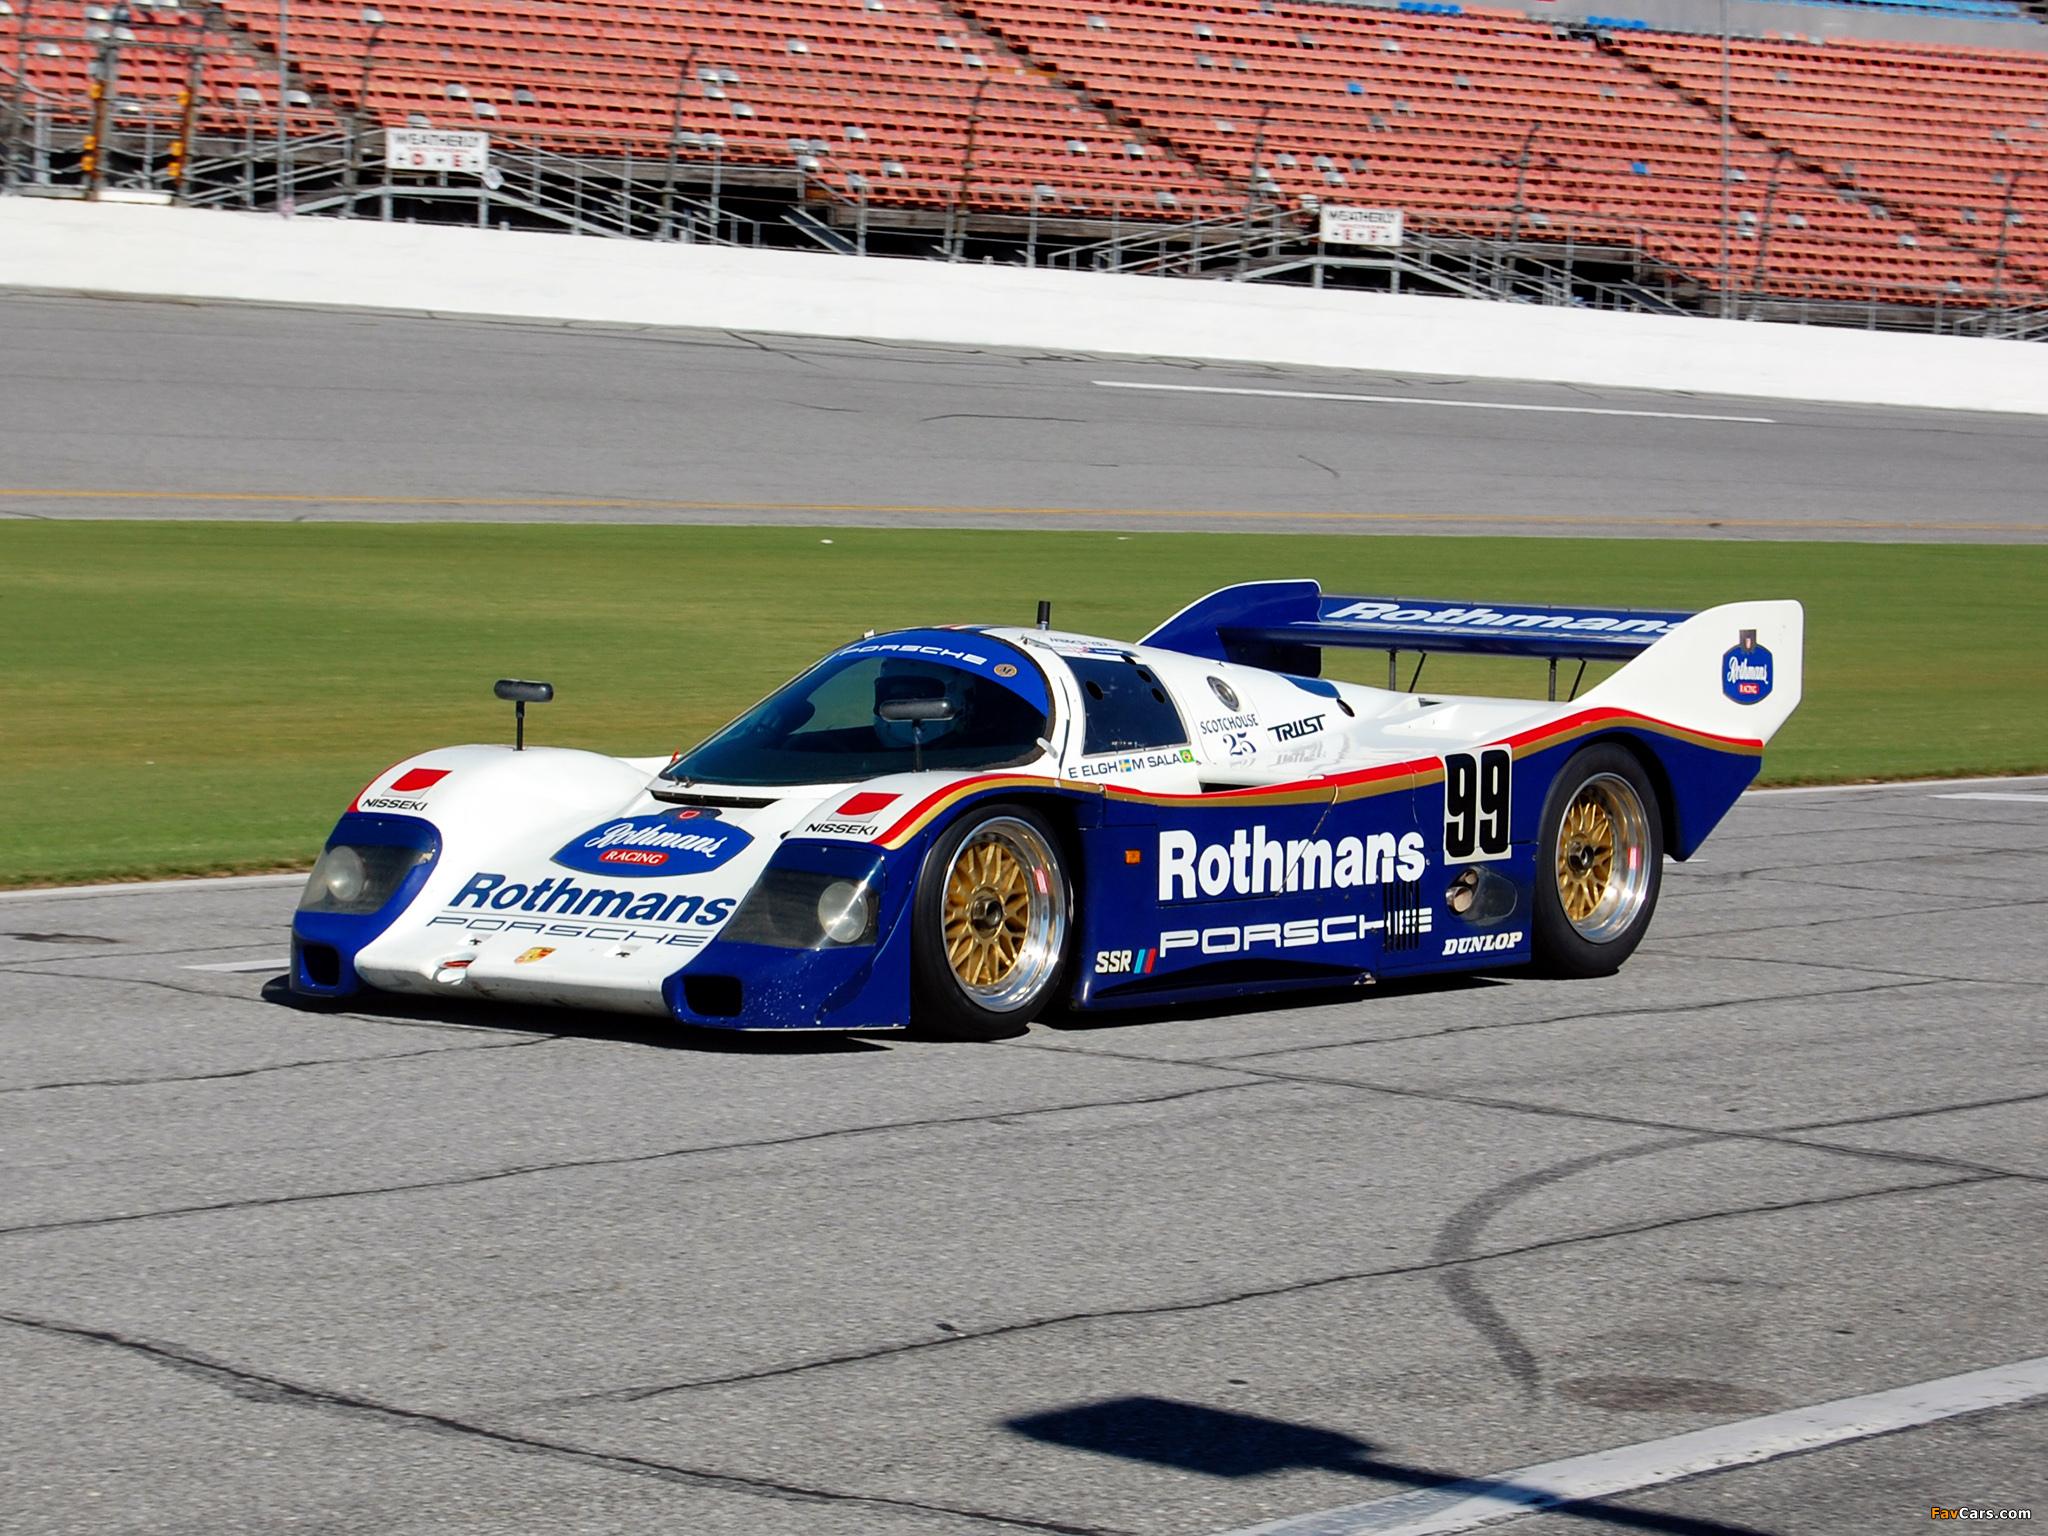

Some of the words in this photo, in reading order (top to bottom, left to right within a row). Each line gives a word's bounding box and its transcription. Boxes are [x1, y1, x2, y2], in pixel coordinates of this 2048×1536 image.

[839, 645, 987, 666] PORSCHE
[1200, 713, 1259, 735] SCOTCHOUSE
[1267, 714, 1326, 743] TRUST
[1222, 732, 1257, 756] 25
[1069, 767, 1079, 779] E
[1082, 760, 1119, 777] ELGH
[1131, 757, 1146, 770] M
[1147, 751, 1181, 768] SALA
[361, 799, 428, 811] NISSEKI
[1444, 749, 1511, 858] 99
[584, 822, 728, 858] Rothmans
[804, 823, 879, 836] NISSEKI
[605, 851, 663, 865] RACING
[1158, 825, 1426, 901] Rothmans
[447, 872, 736, 926] Rothmans
[426, 916, 708, 947] PORSCHE
[1159, 907, 1433, 958] PORSCHE
[1442, 931, 1523, 956] DUNLOP
[1095, 950, 1133, 974] SSR
